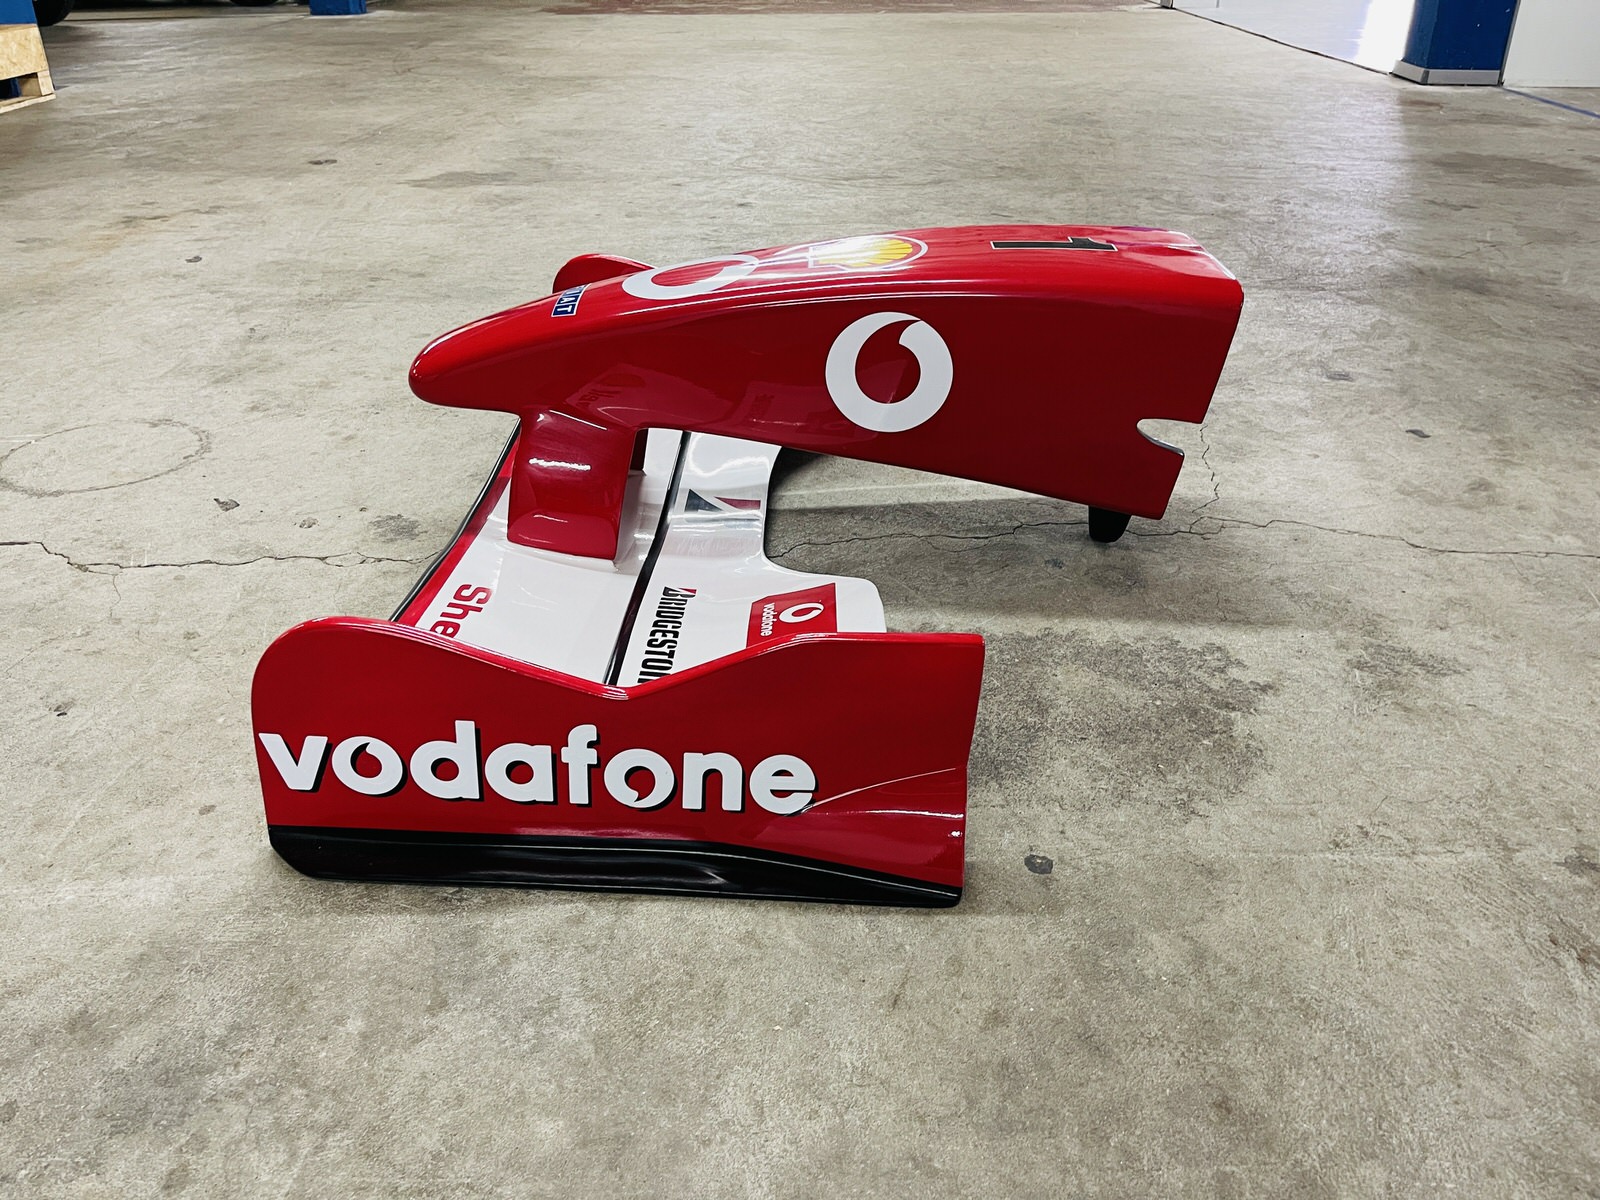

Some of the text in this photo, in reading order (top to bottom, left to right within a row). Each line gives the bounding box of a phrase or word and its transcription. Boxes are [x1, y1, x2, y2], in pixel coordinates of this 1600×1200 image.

[990, 236, 1118, 251] 1
[760, 602, 777, 636] vodafone
[259, 720, 817, 814] vodafone
